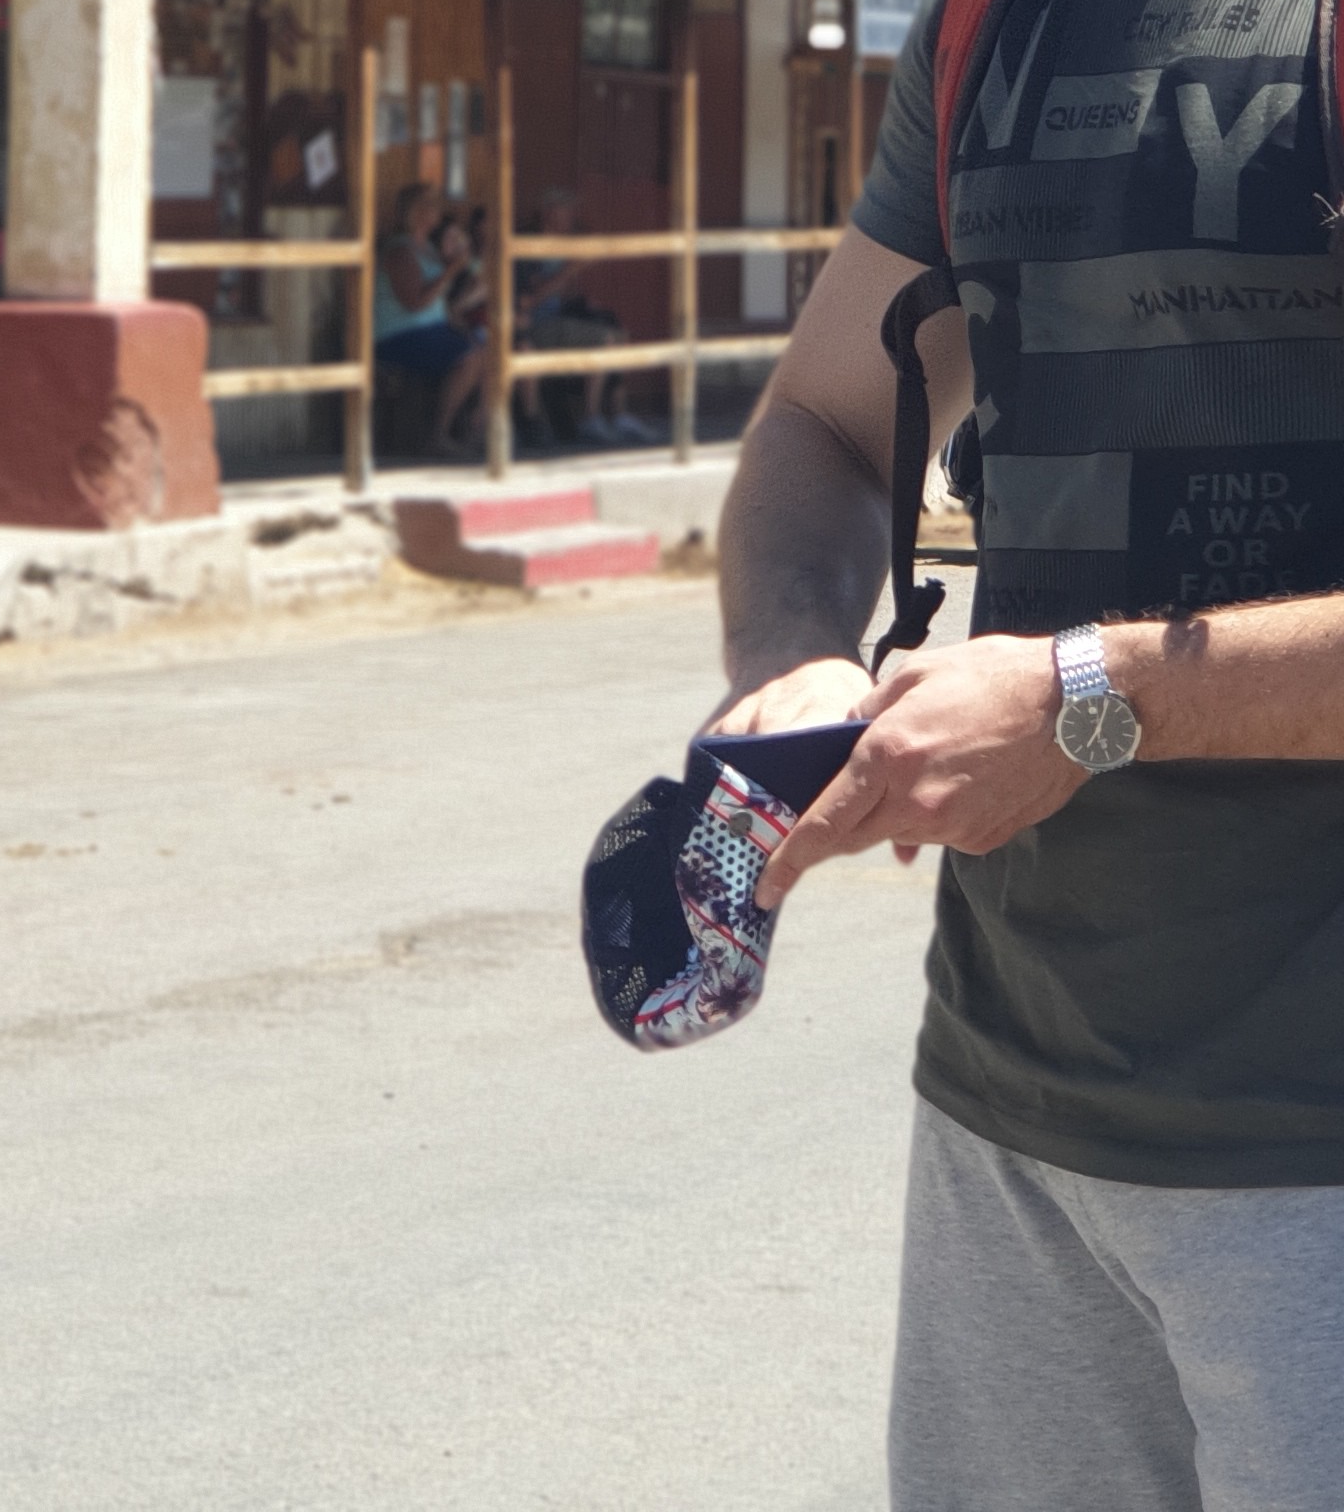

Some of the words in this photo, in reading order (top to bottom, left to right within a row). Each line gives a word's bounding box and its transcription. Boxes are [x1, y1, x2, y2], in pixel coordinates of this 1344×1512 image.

[1044, 99, 1141, 133] QUEENS
[1127, 283, 1344, 321] MANHATTAN
[1187, 472, 1290, 502] FIND
[1165, 506, 1194, 535] A
[1207, 503, 1313, 535] WAY
[1202, 539, 1271, 568] OR
